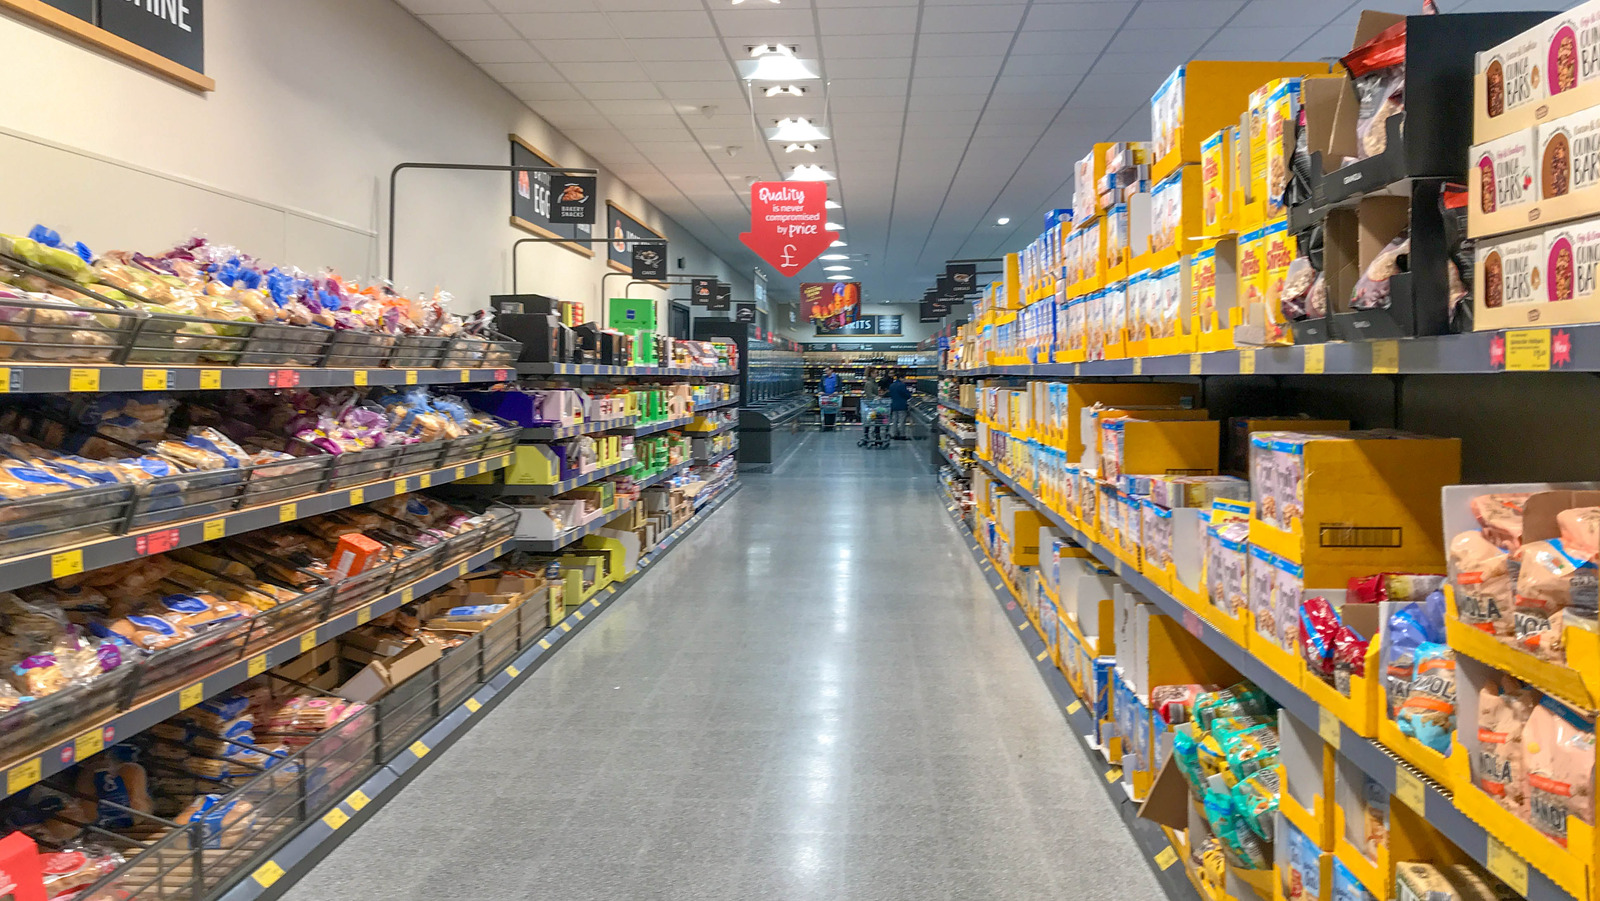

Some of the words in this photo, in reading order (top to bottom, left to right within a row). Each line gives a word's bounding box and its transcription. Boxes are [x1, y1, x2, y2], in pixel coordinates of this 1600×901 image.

[758, 187, 805, 205] Quality
[772, 204, 780, 212] is
[765, 212, 820, 223] compromised
[776, 225, 788, 236] by
[789, 222, 818, 238] price
[780, 244, 798, 267] £
